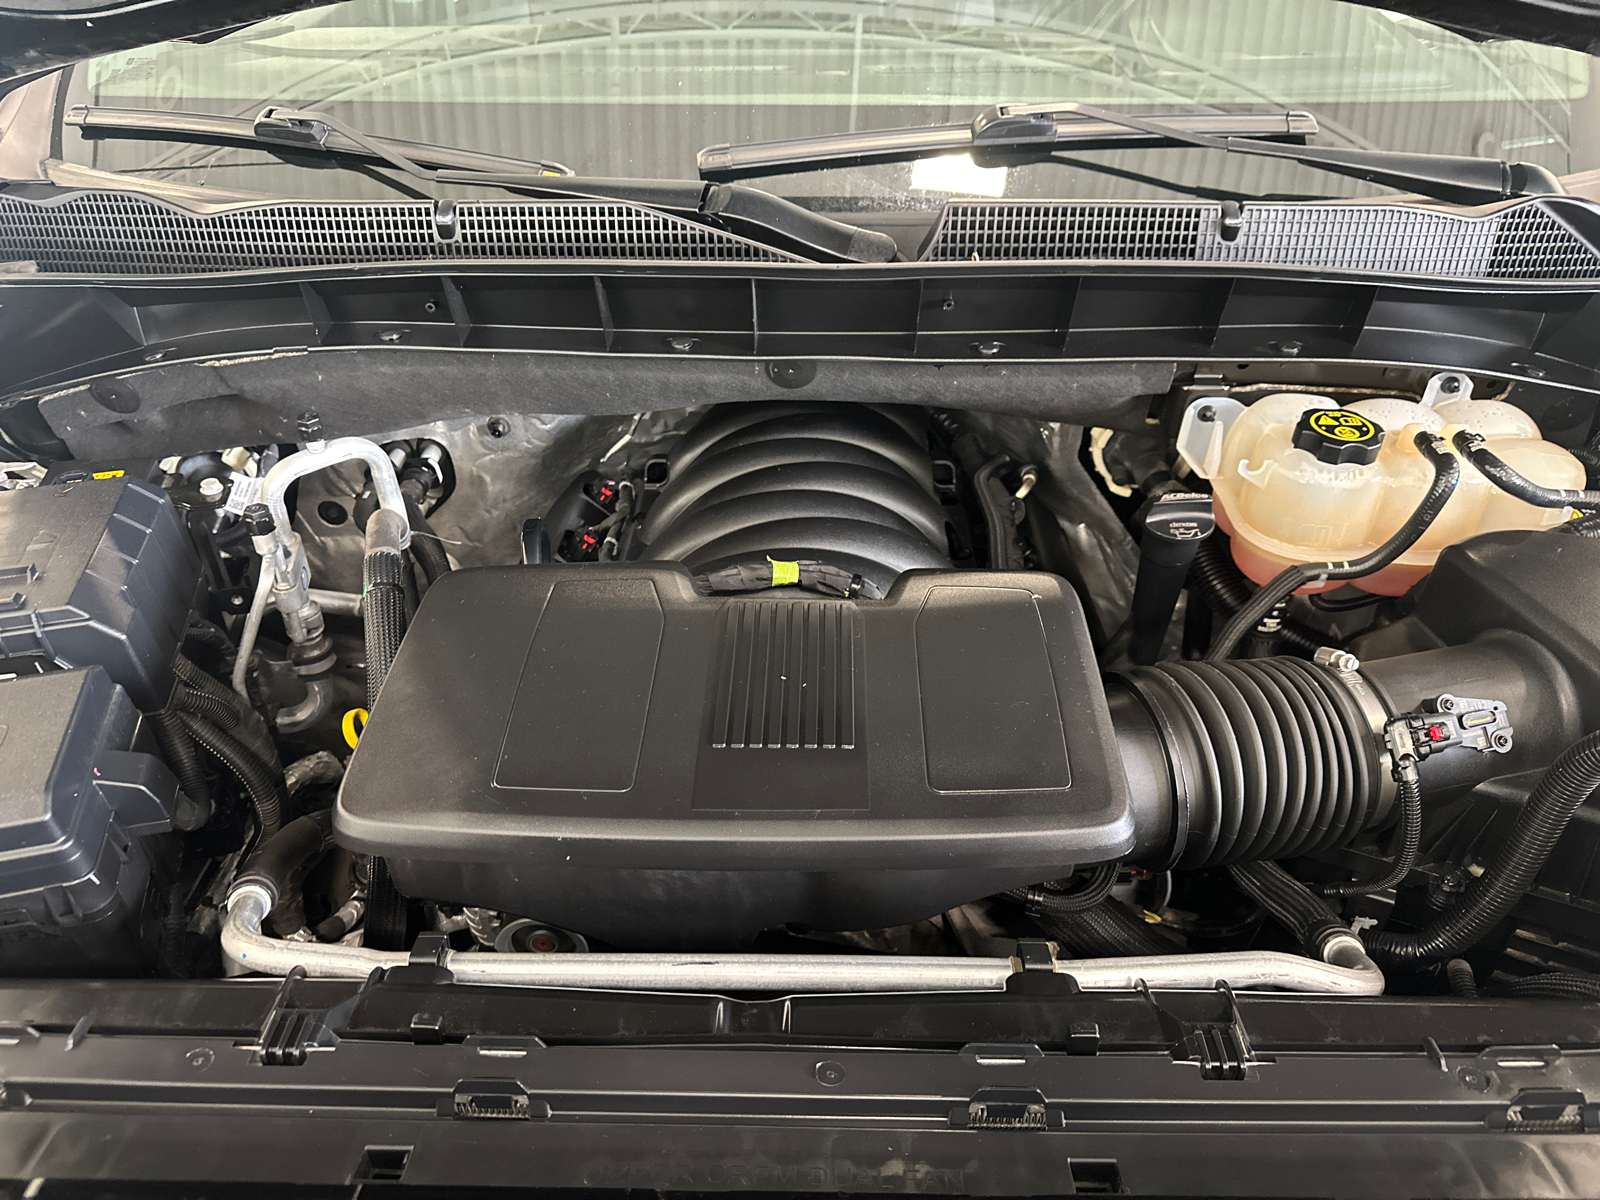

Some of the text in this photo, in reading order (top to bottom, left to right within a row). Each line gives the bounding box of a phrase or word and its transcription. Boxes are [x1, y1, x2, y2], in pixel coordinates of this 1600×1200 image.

[1160, 492, 1209, 502] ACDelco
[810, 1166, 895, 1189] DUAL
[903, 1168, 966, 1191] FAN
